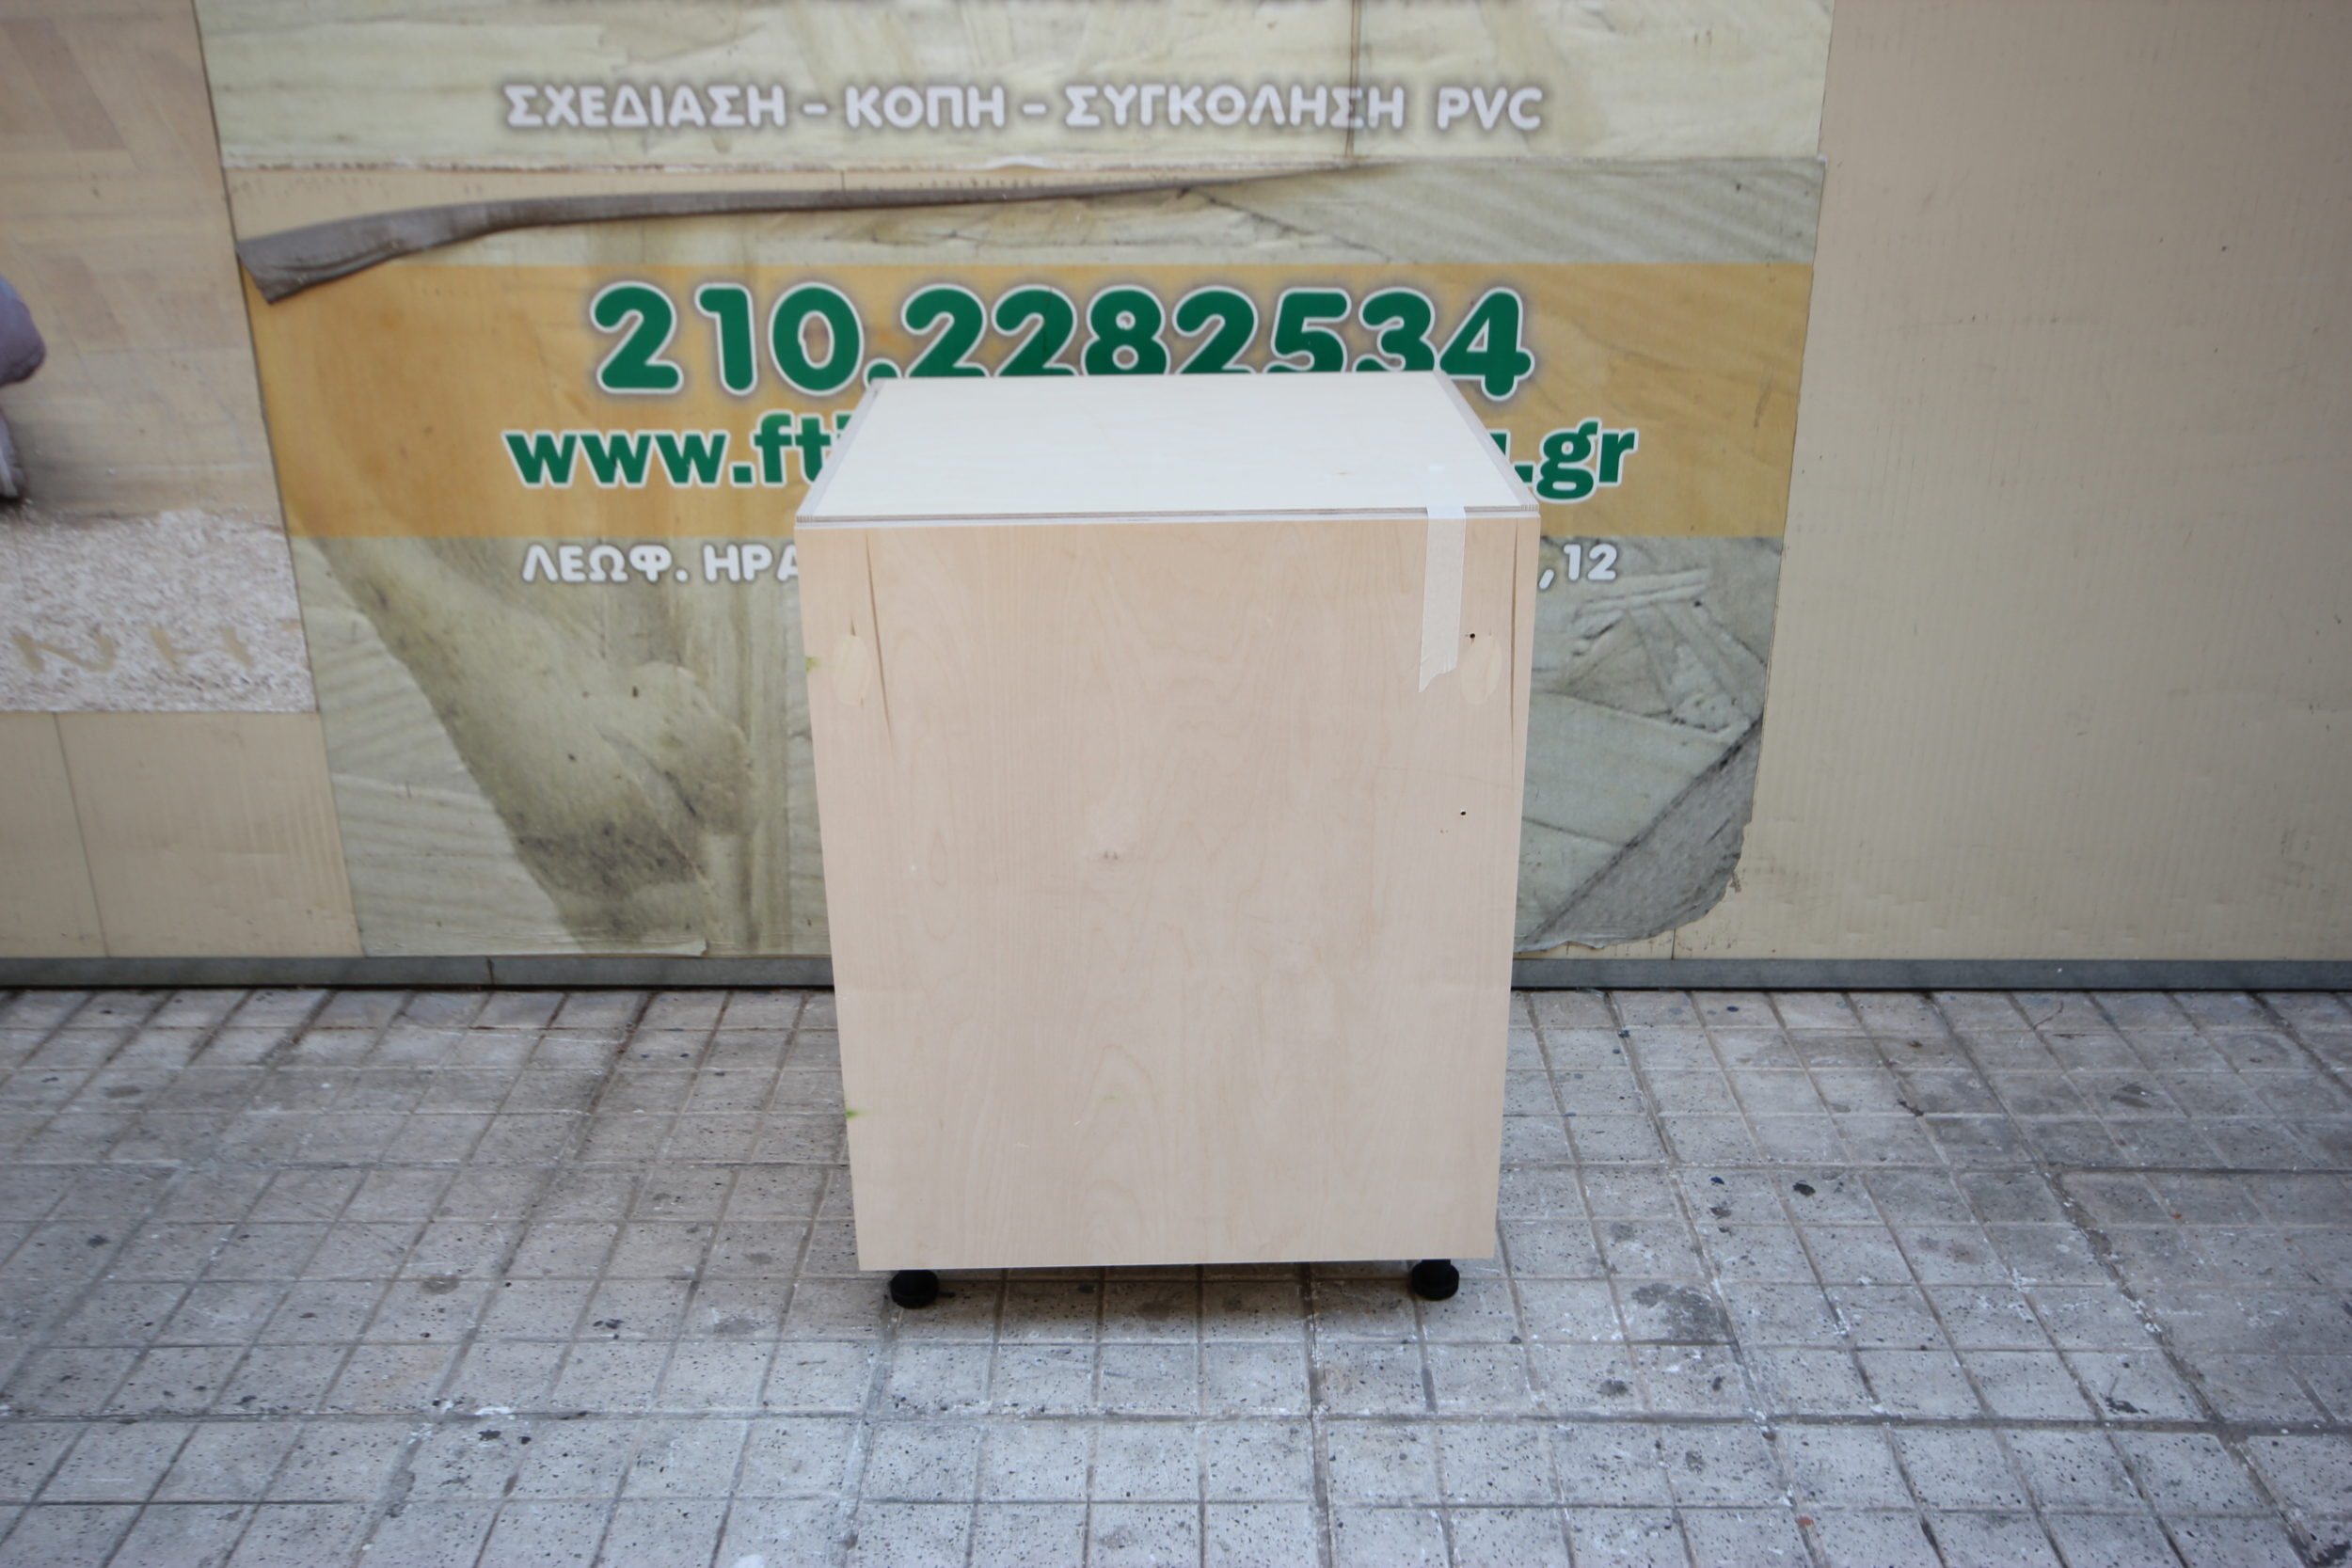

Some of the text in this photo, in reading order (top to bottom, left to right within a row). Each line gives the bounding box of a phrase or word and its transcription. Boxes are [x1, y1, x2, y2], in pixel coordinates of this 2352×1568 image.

[503, 85, 787, 127] ΣΧΕΔΙΑΣΗ
[845, 86, 1005, 128] ΚΟΠΗ
[1065, 84, 1405, 128] ΣΥΓΚΟΛΗΣΗ
[1438, 87, 1543, 131] PVC
[590, 281, 1534, 399] 210.2282534
[523, 545, 690, 582] ΛΕΩΦ.
